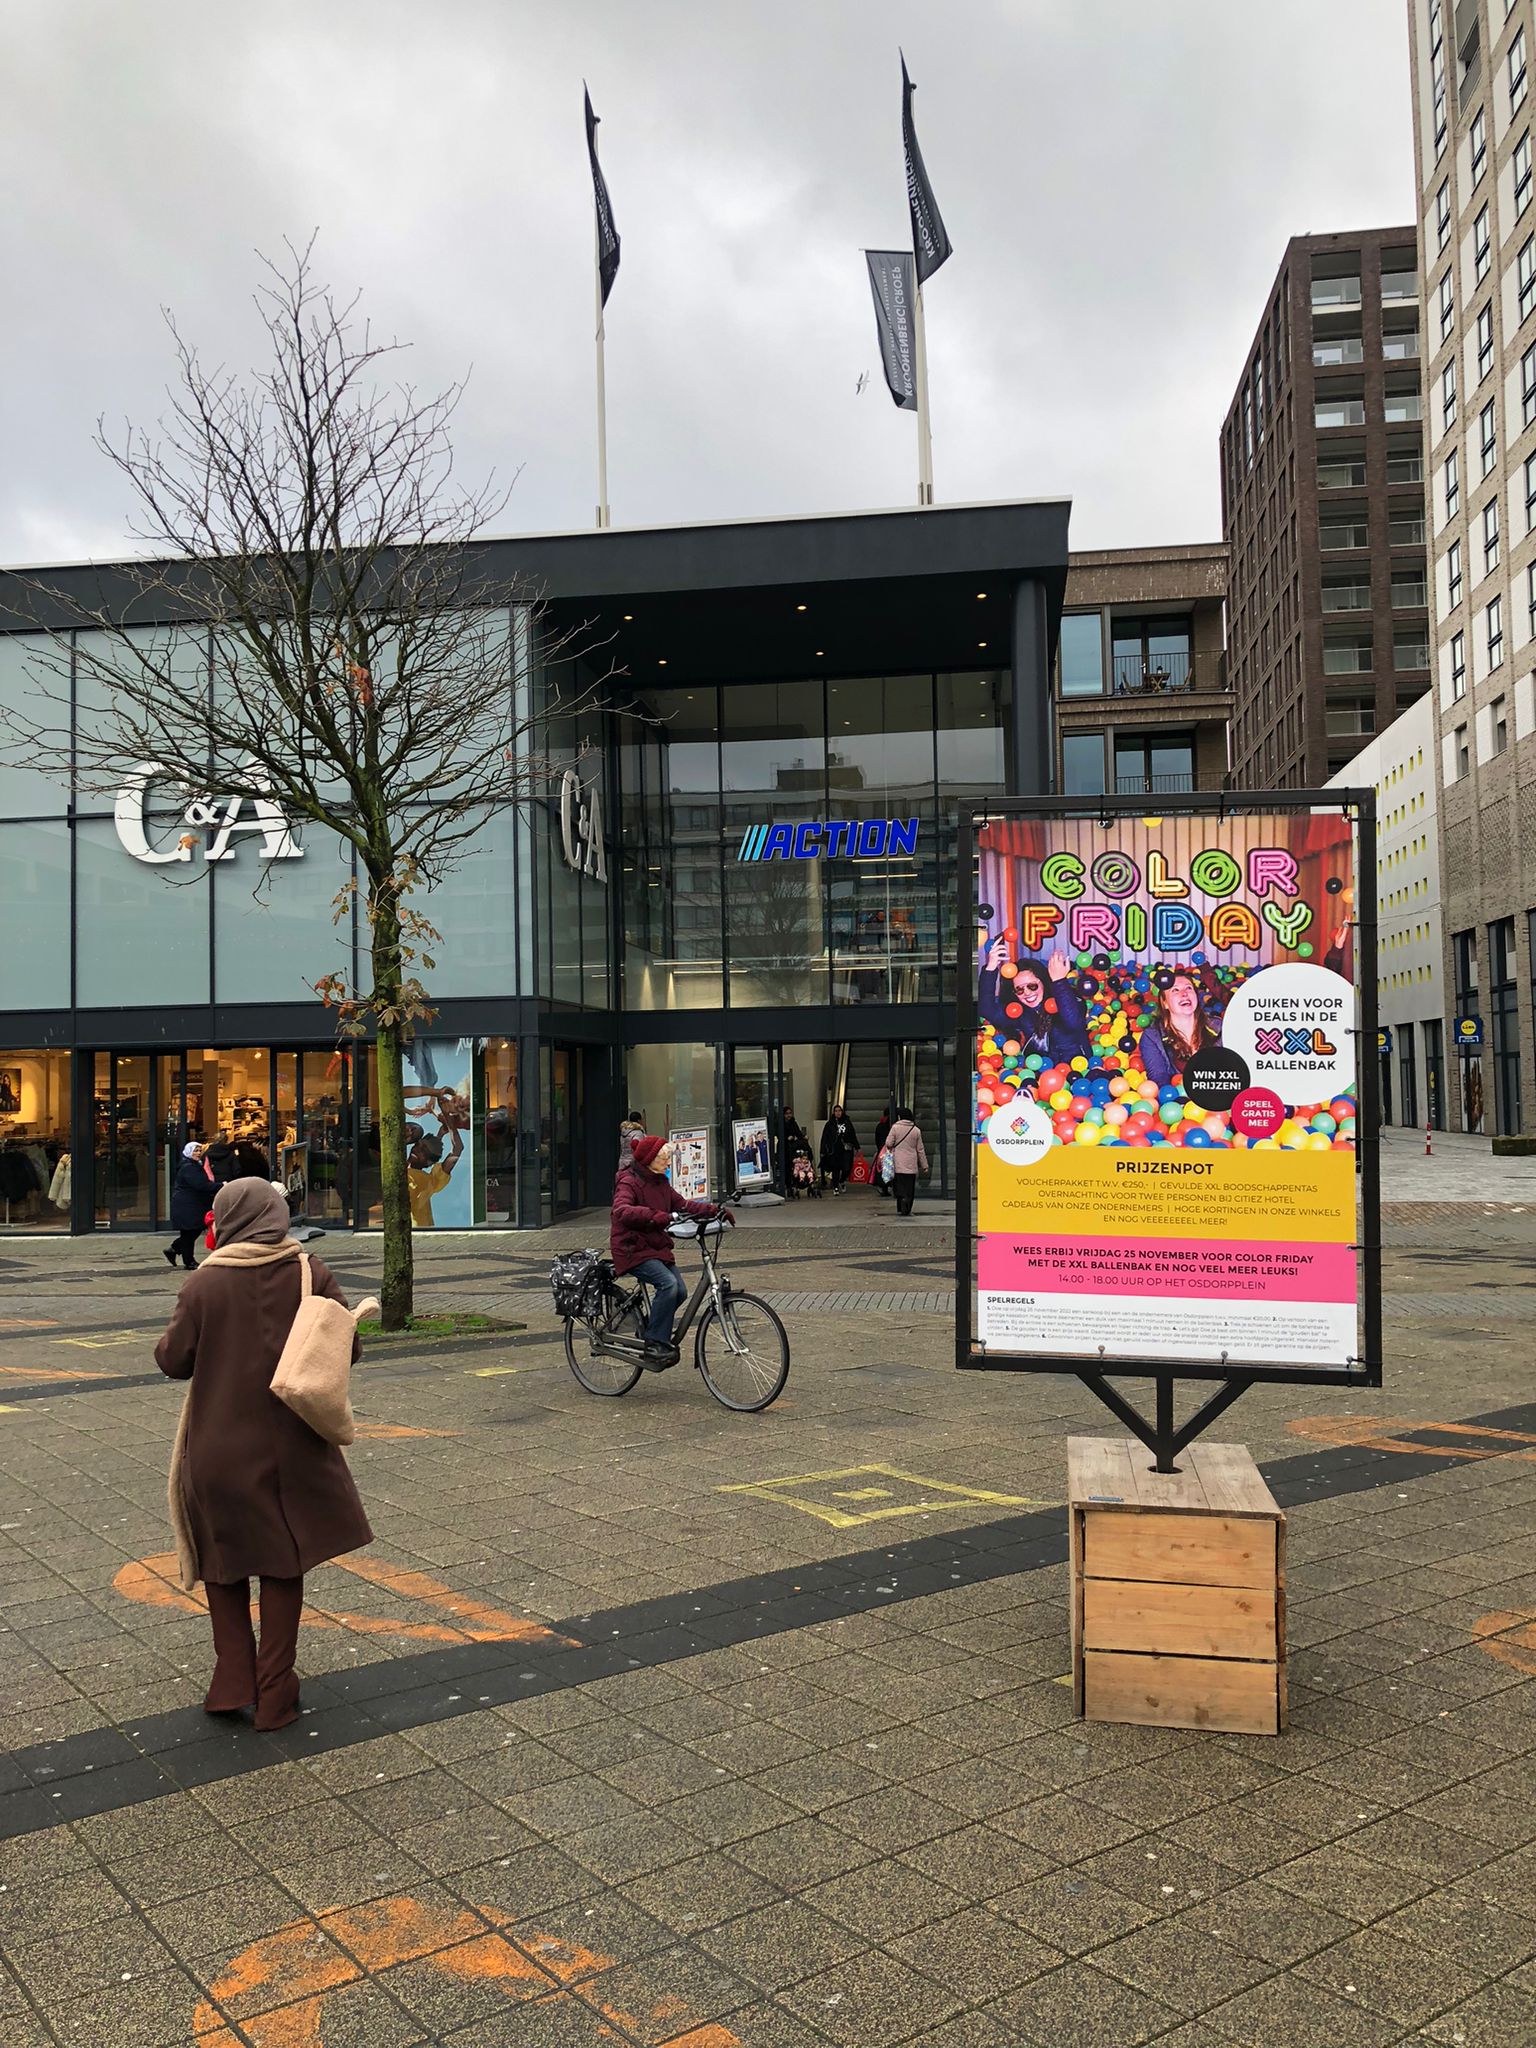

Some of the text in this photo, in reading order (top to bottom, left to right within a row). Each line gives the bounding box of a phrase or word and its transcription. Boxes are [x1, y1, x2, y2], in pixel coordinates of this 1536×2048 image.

[114, 757, 304, 864] C&A
[561, 770, 607, 883] C&A
[762, 817, 920, 861] ACTION
[1040, 847, 1300, 899] COLOR
[1022, 901, 1314, 952] FRIDAY
[1248, 998, 1343, 1008] DUIKEN VOOR
[1254, 1012, 1338, 1021] DEALS IN DE
[1255, 1027, 1337, 1055] XXL
[1256, 1060, 1336, 1070] BALLENBAK
[1193, 1070, 1240, 1080] WIN XXL
[1192, 1081, 1242, 1090] PRIJZEN!
[1243, 1100, 1273, 1108] SPEEL
[1241, 1109, 1276, 1118] GRATIS
[1248, 1119, 1269, 1127] MEE
[1116, 1161, 1214, 1175] PRIJZENPOT
[1017, 1178, 1093, 1187] VOUCHERPAKKET
[1121, 1180, 1149, 1189] €250,-
[1160, 1181, 1203, 1190] GEVULDE
[1205, 1182, 1221, 1191] XXL
[1223, 1183, 1318, 1193] BOODSCHAPPENTAS
[1038, 1190, 1295, 1204] OVERNACHTING VOOR TWEE PERSONEN BIJ CITIEZ HOTEL
[1001, 1200, 1044, 1208] CADEAUS
[1066, 1202, 1090, 1210] ONZE
[1093, 1203, 1163, 1212] ONDERNEMERS
[1174, 1205, 1200, 1213] HOGE
[1203, 1206, 1257, 1215] KORTINGEN
[1259, 1207, 1268, 1215] IN
[1270, 1208, 1296, 1216] ONZE
[1299, 1208, 1341, 1217] WINKELS
[1103, 1214, 1116, 1222] EN
[1118, 1215, 1138, 1223] NOG
[1199, 1217, 1228, 1225] MEER!
[1013, 1246, 1314, 1264] WEES ERBIJ VRIJDAG 25 NOVEMBER VOOR COLOR FRIDAY
[1028, 1258, 1298, 1276] MET DE XXL BALLENBAK EN NOG VEEL MEER LEUKS!
[1058, 1274, 1085, 1284] 14.00
[1093, 1275, 1119, 1285] 18.00
[1121, 1277, 1144, 1286] UUR
[1146, 1277, 1162, 1286] OP
[1165, 1278, 1186, 1287] HET
[1188, 1279, 1266, 1290] OSDORPPLEIN
[987, 1296, 1035, 1305] SPELREGELS
